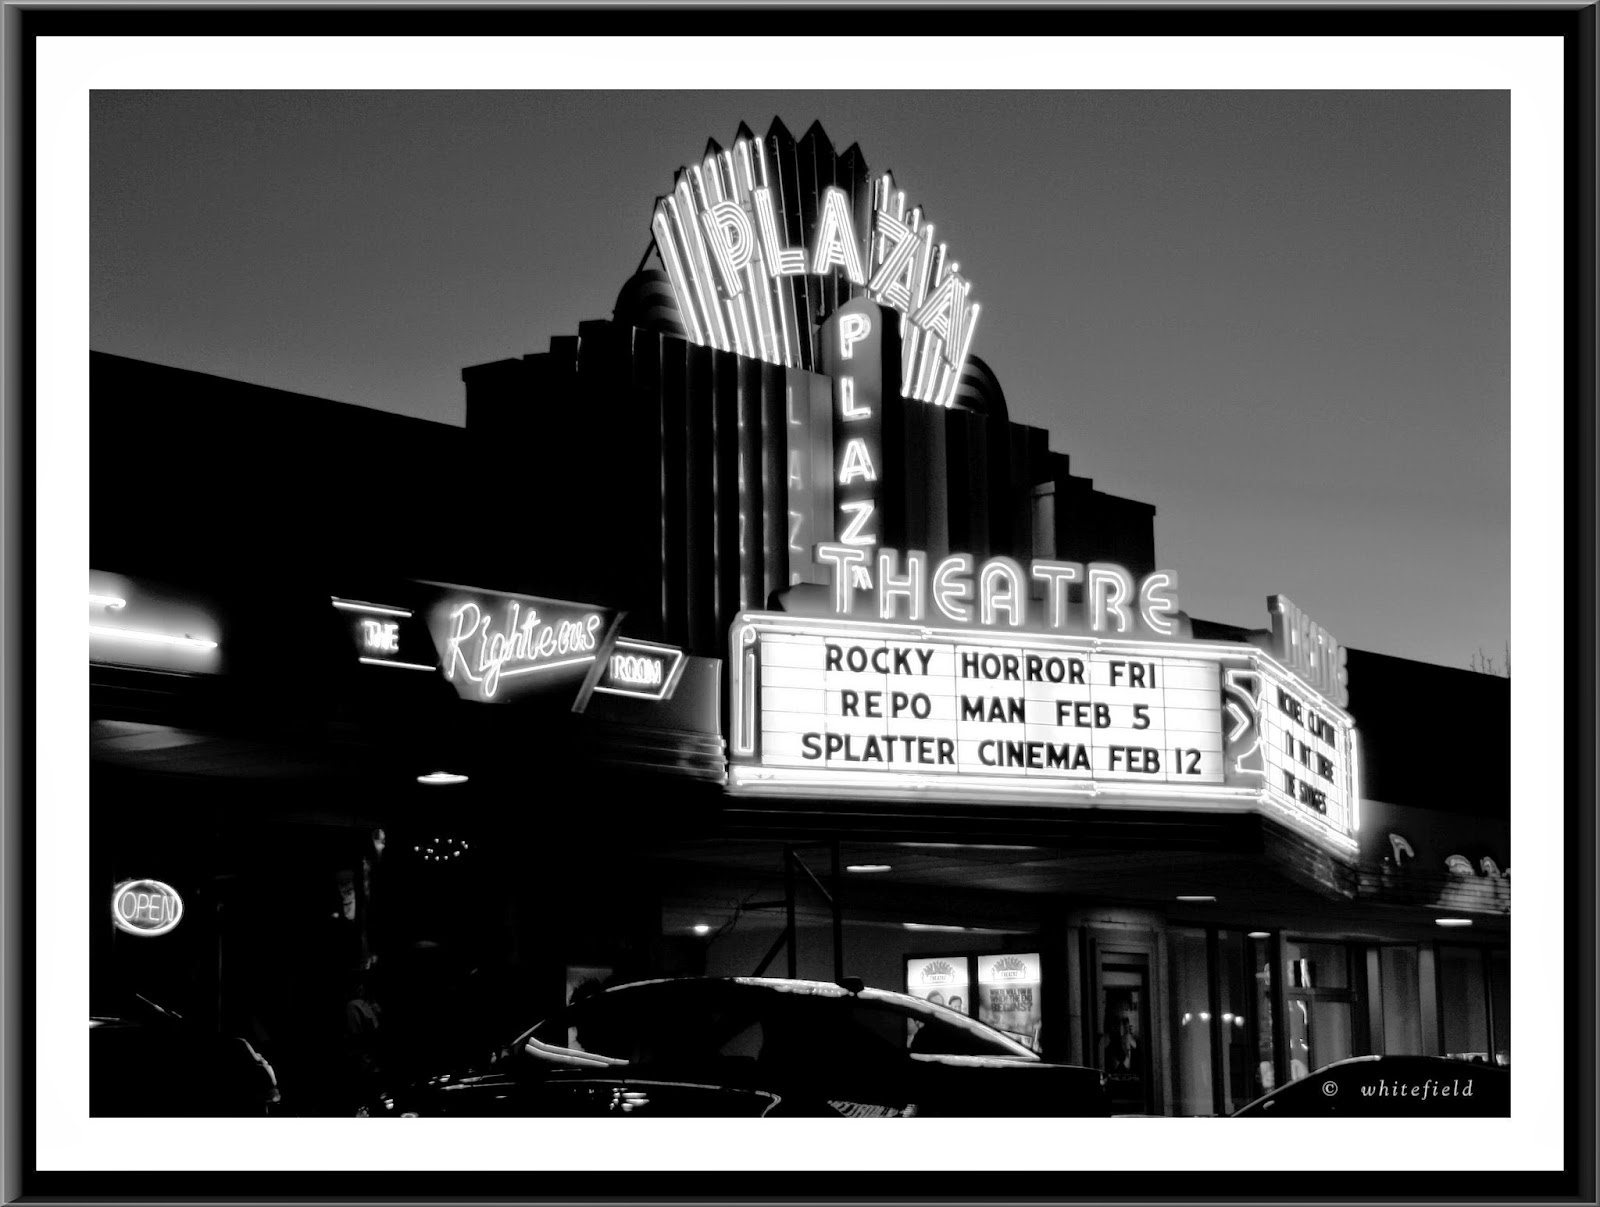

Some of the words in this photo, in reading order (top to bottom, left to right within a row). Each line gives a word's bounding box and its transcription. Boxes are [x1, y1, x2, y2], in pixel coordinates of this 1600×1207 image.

[701, 186, 968, 372] PLAZA
[815, 542, 1179, 636] THEATRE
[447, 601, 601, 697] Righteous
[610, 654, 664, 684] ROOM
[825, 644, 934, 676] ROCKY
[961, 652, 1086, 686] HORROR
[1109, 660, 1156, 689] FRI
[842, 689, 932, 720] REPO
[961, 695, 1026, 724] MAN
[1055, 700, 1111, 729] FEB
[1132, 703, 1151, 730] 5
[802, 732, 956, 765] SPLATTER
[978, 740, 1091, 772] CINEMA
[1108, 746, 1160, 775] FEB
[1175, 747, 1202, 776] 12
[121, 891, 175, 922] OPEN
